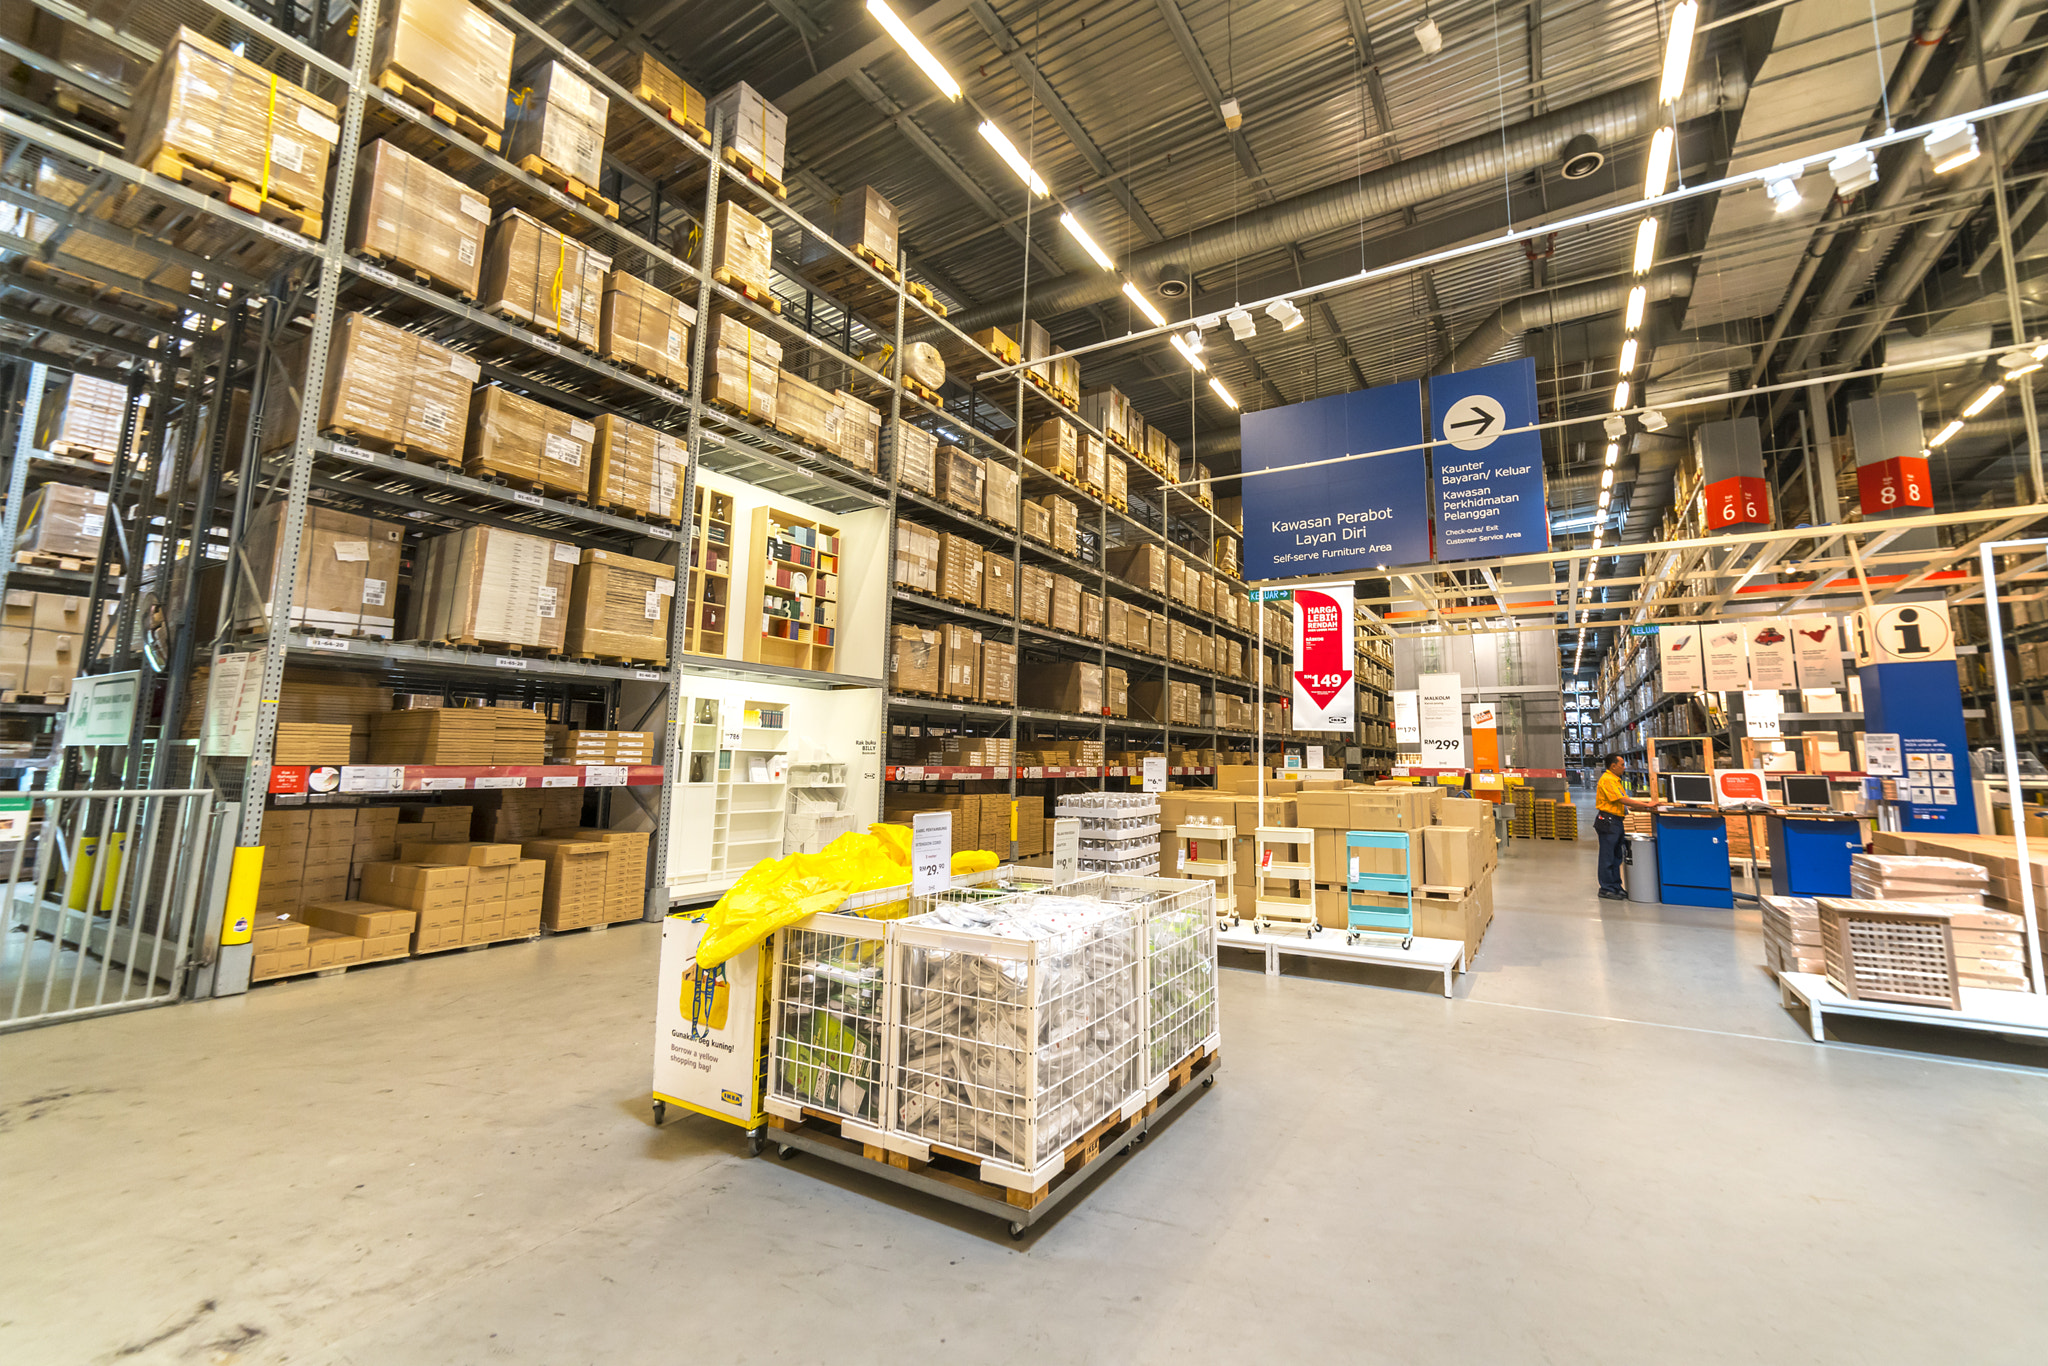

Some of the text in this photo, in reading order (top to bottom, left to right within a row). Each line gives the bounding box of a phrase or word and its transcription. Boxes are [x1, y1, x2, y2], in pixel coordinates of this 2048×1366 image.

[1441, 461, 1484, 475] Kaunter
[1442, 465, 1532, 485] Bayaran/ Keluar
[1443, 486, 1491, 500] Kawasan
[1880, 486, 1896, 504] 8
[1908, 484, 1920, 501] 8
[1444, 494, 1520, 511] Perkhidmatan
[1746, 502, 1757, 518] 6
[1272, 507, 1394, 533] Kawasan Perabot
[1444, 507, 1500, 522] Pelanggan
[1723, 504, 1736, 520] 6
[1296, 526, 1367, 546] Layan Diri
[1446, 536, 1478, 546] Customer
[1479, 534, 1504, 542] Service
[1273, 543, 1392, 564] Self-serve Furniture Area
[1250, 590, 1279, 600] KEUAR
[1307, 606, 1337, 614] HARGA
[1307, 613, 1337, 622] LEBIH
[1632, 626, 1660, 635] KELUAR
[699, 1037, 709, 1047] beg
[712, 1040, 734, 1053] kuning!
[670, 1044, 692, 1055] Borrow
[699, 1052, 719, 1063] yellow
[670, 1054, 711, 1073] shopping bag!
[723, 1092, 741, 1103] IKEA
